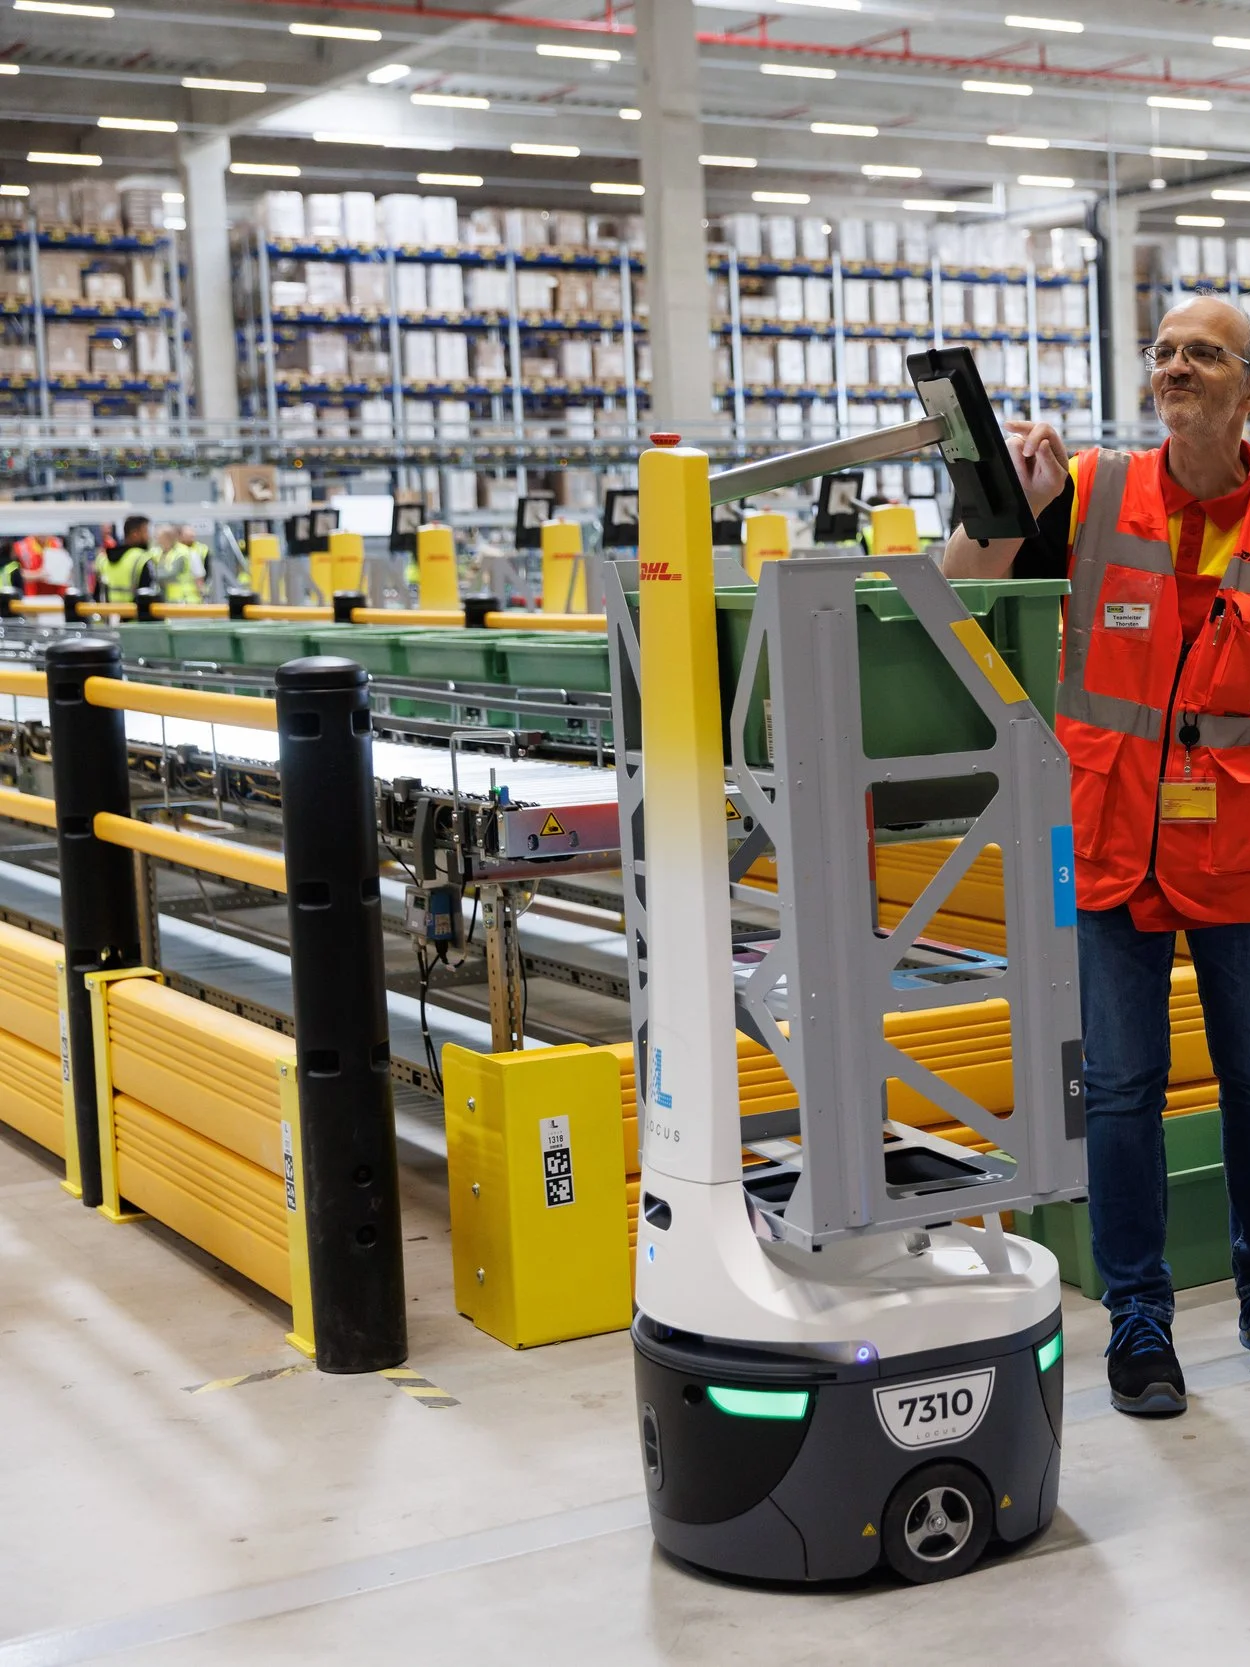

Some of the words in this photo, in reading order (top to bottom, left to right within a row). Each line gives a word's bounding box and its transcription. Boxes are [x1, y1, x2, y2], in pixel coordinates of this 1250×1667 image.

[640, 562, 674, 581] DHL
[983, 652, 993, 669] 1
[1058, 866, 1070, 883] 3
[1069, 1079, 1080, 1097] 5
[548, 1134, 564, 1144] 1318
[647, 1119, 681, 1143] OCUS
[898, 1388, 973, 1427] 7310
[916, 1427, 957, 1440] LOCUS
